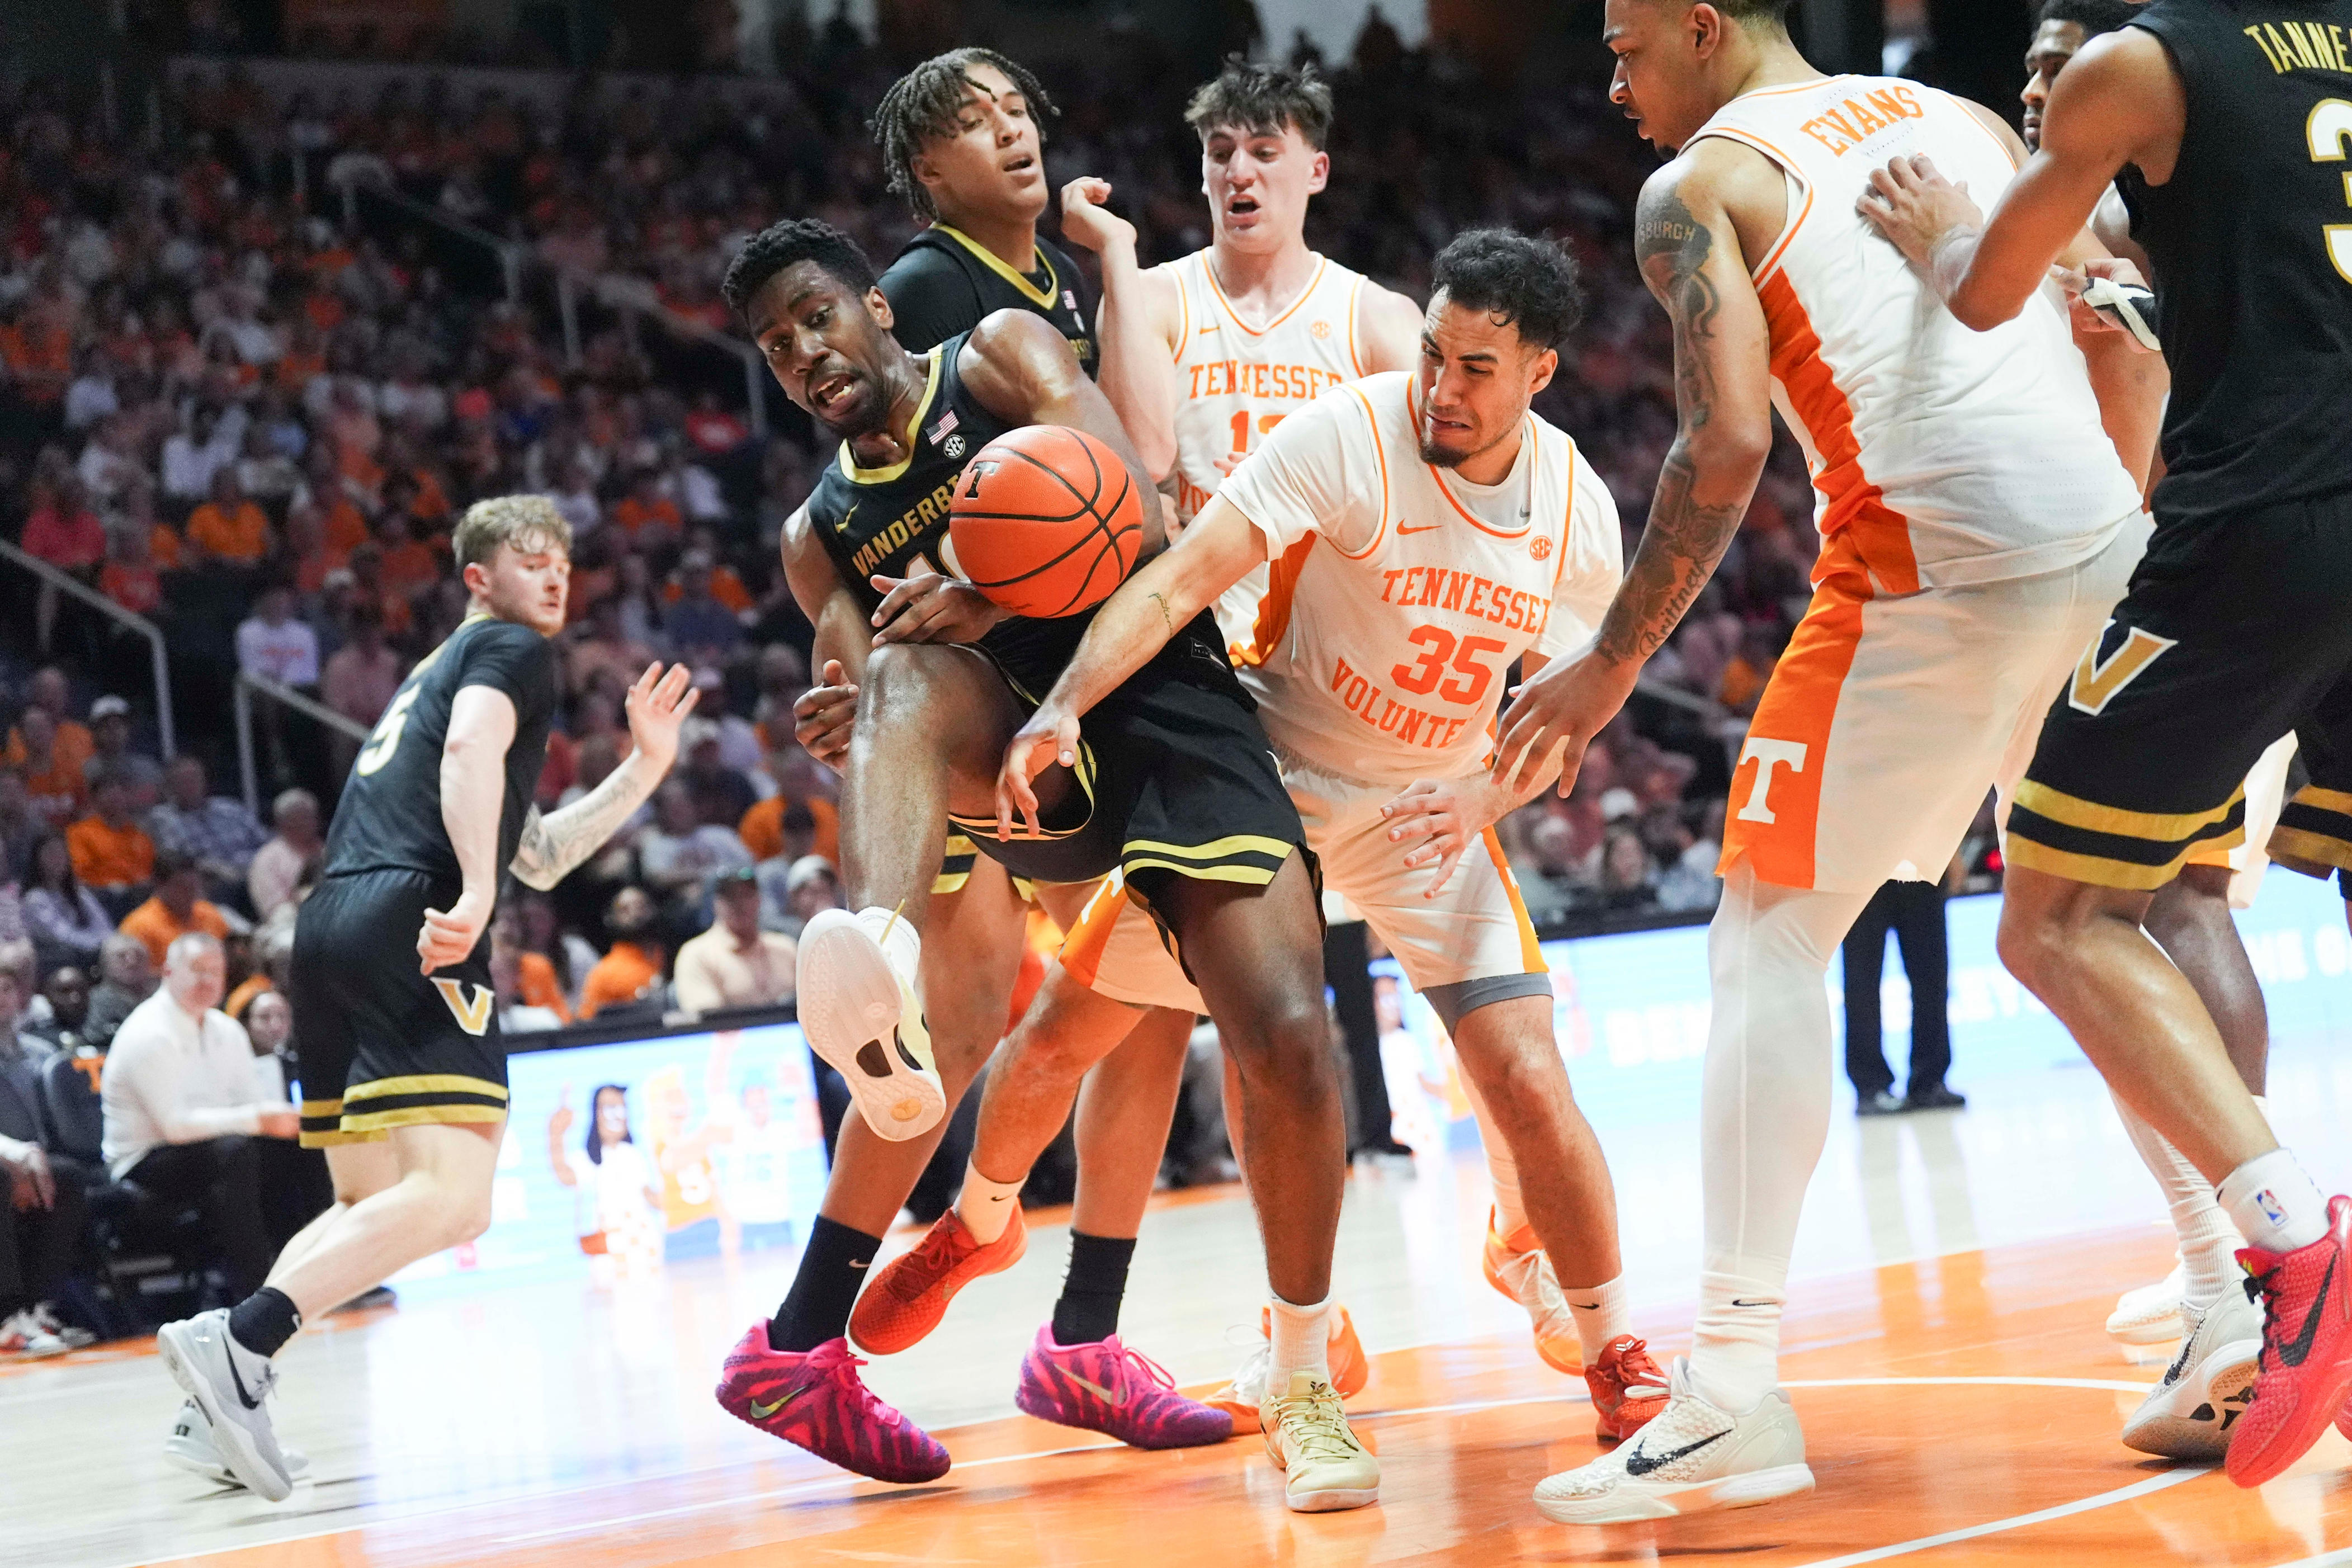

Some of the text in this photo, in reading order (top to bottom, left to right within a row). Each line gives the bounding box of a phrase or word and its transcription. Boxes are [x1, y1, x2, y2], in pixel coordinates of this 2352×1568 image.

[2244, 21, 2352, 75] TANNE
[1800, 86, 1924, 157] EVANS
[944, 435, 964, 457] SEC
[964, 461, 1000, 499] T
[1532, 538, 1550, 558] SEC
[1391, 624, 1508, 705] 35
[2068, 618, 2179, 716] V
[357, 681, 420, 777] 5
[1331, 657, 1476, 748] VOLUNTE
[1737, 736, 1808, 825] T
[429, 977, 495, 1036] V
